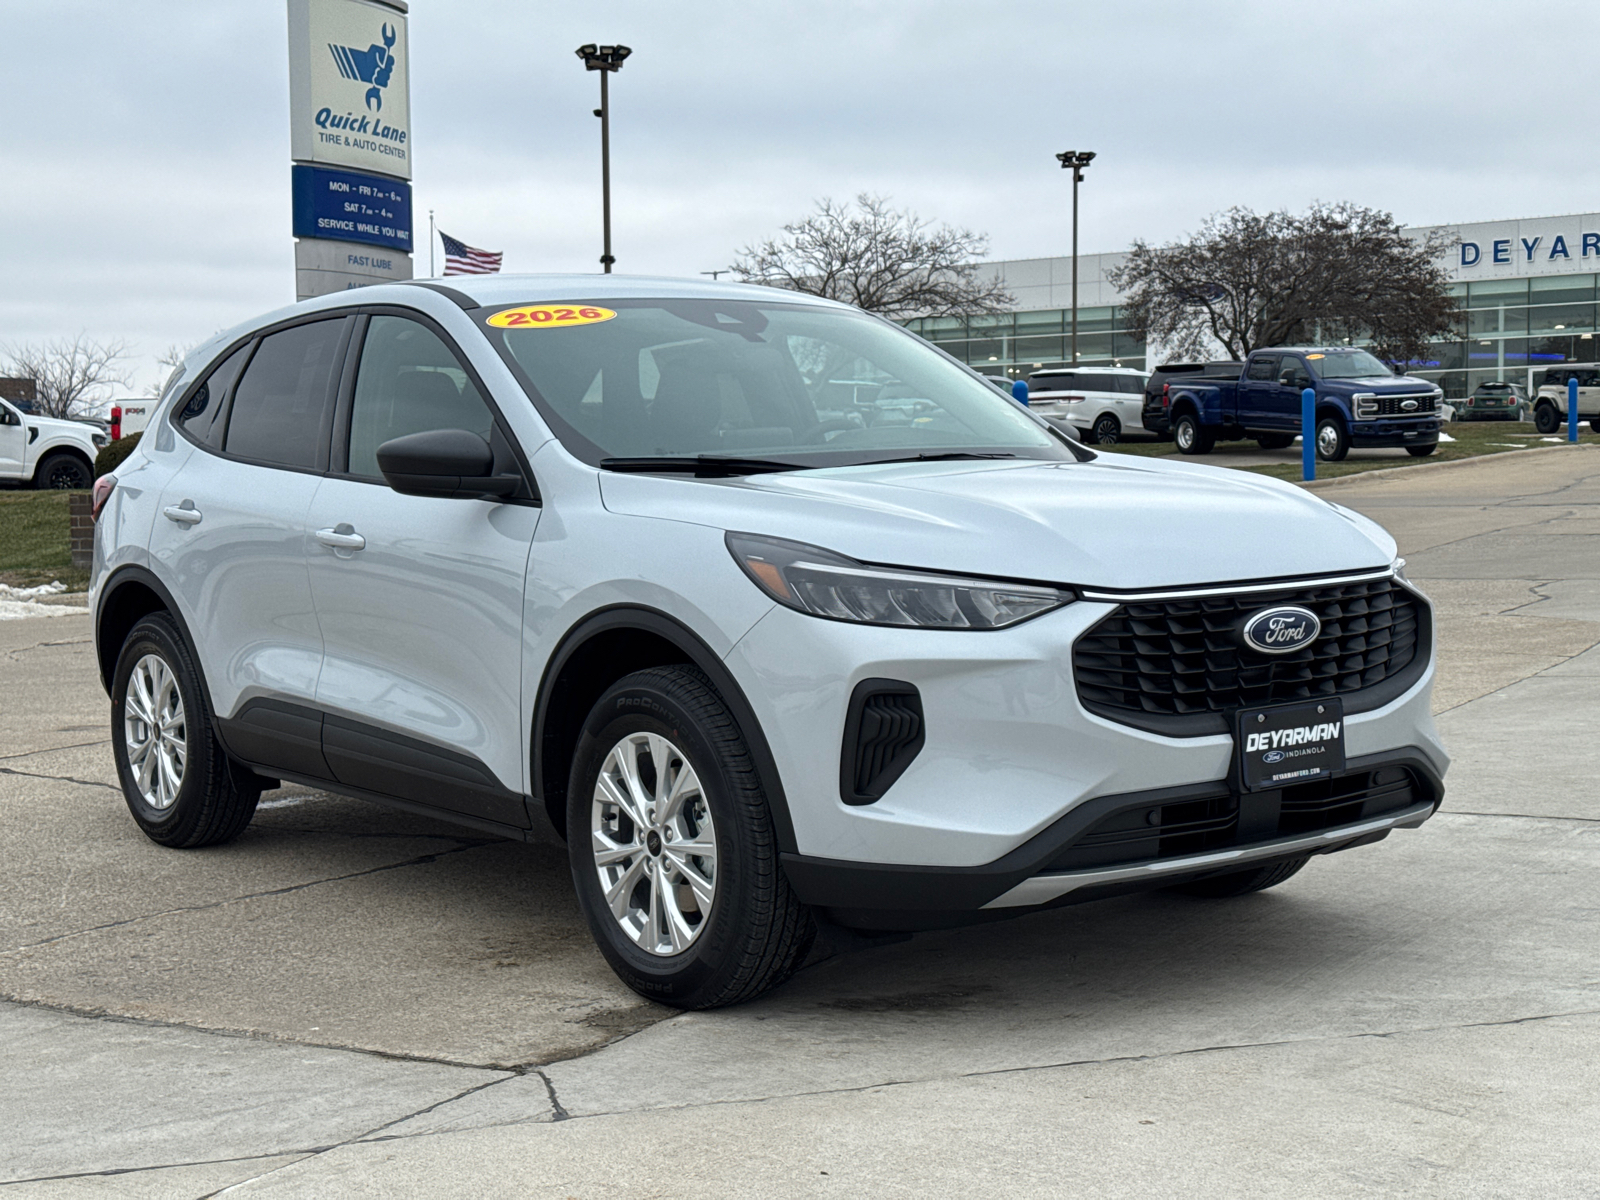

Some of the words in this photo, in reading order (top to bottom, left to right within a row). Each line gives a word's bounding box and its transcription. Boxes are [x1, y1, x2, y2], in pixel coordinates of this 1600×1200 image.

[315, 107, 371, 134] Quick
[372, 118, 406, 144] Lane
[318, 132, 342, 146] TIRE
[344, 136, 351, 147] &
[352, 138, 377, 152] AUTO
[378, 143, 406, 160] CENTER
[329, 181, 350, 193] MON
[358, 185, 372, 196] FRI
[344, 202, 359, 213] SAT
[317, 217, 355, 231] SERVICE
[356, 222, 380, 235] WHILE
[381, 226, 396, 238] YOU
[396, 229, 410, 240] WAIT
[347, 254, 370, 267] FAST
[371, 258, 393, 270] LUBE
[504, 308, 604, 326] 2026
[1265, 616, 1306, 644] Ford
[1245, 721, 1341, 753] DEYARMAN
[1266, 752, 1281, 762] Ford
[1286, 745, 1326, 758] INDIANOLA
